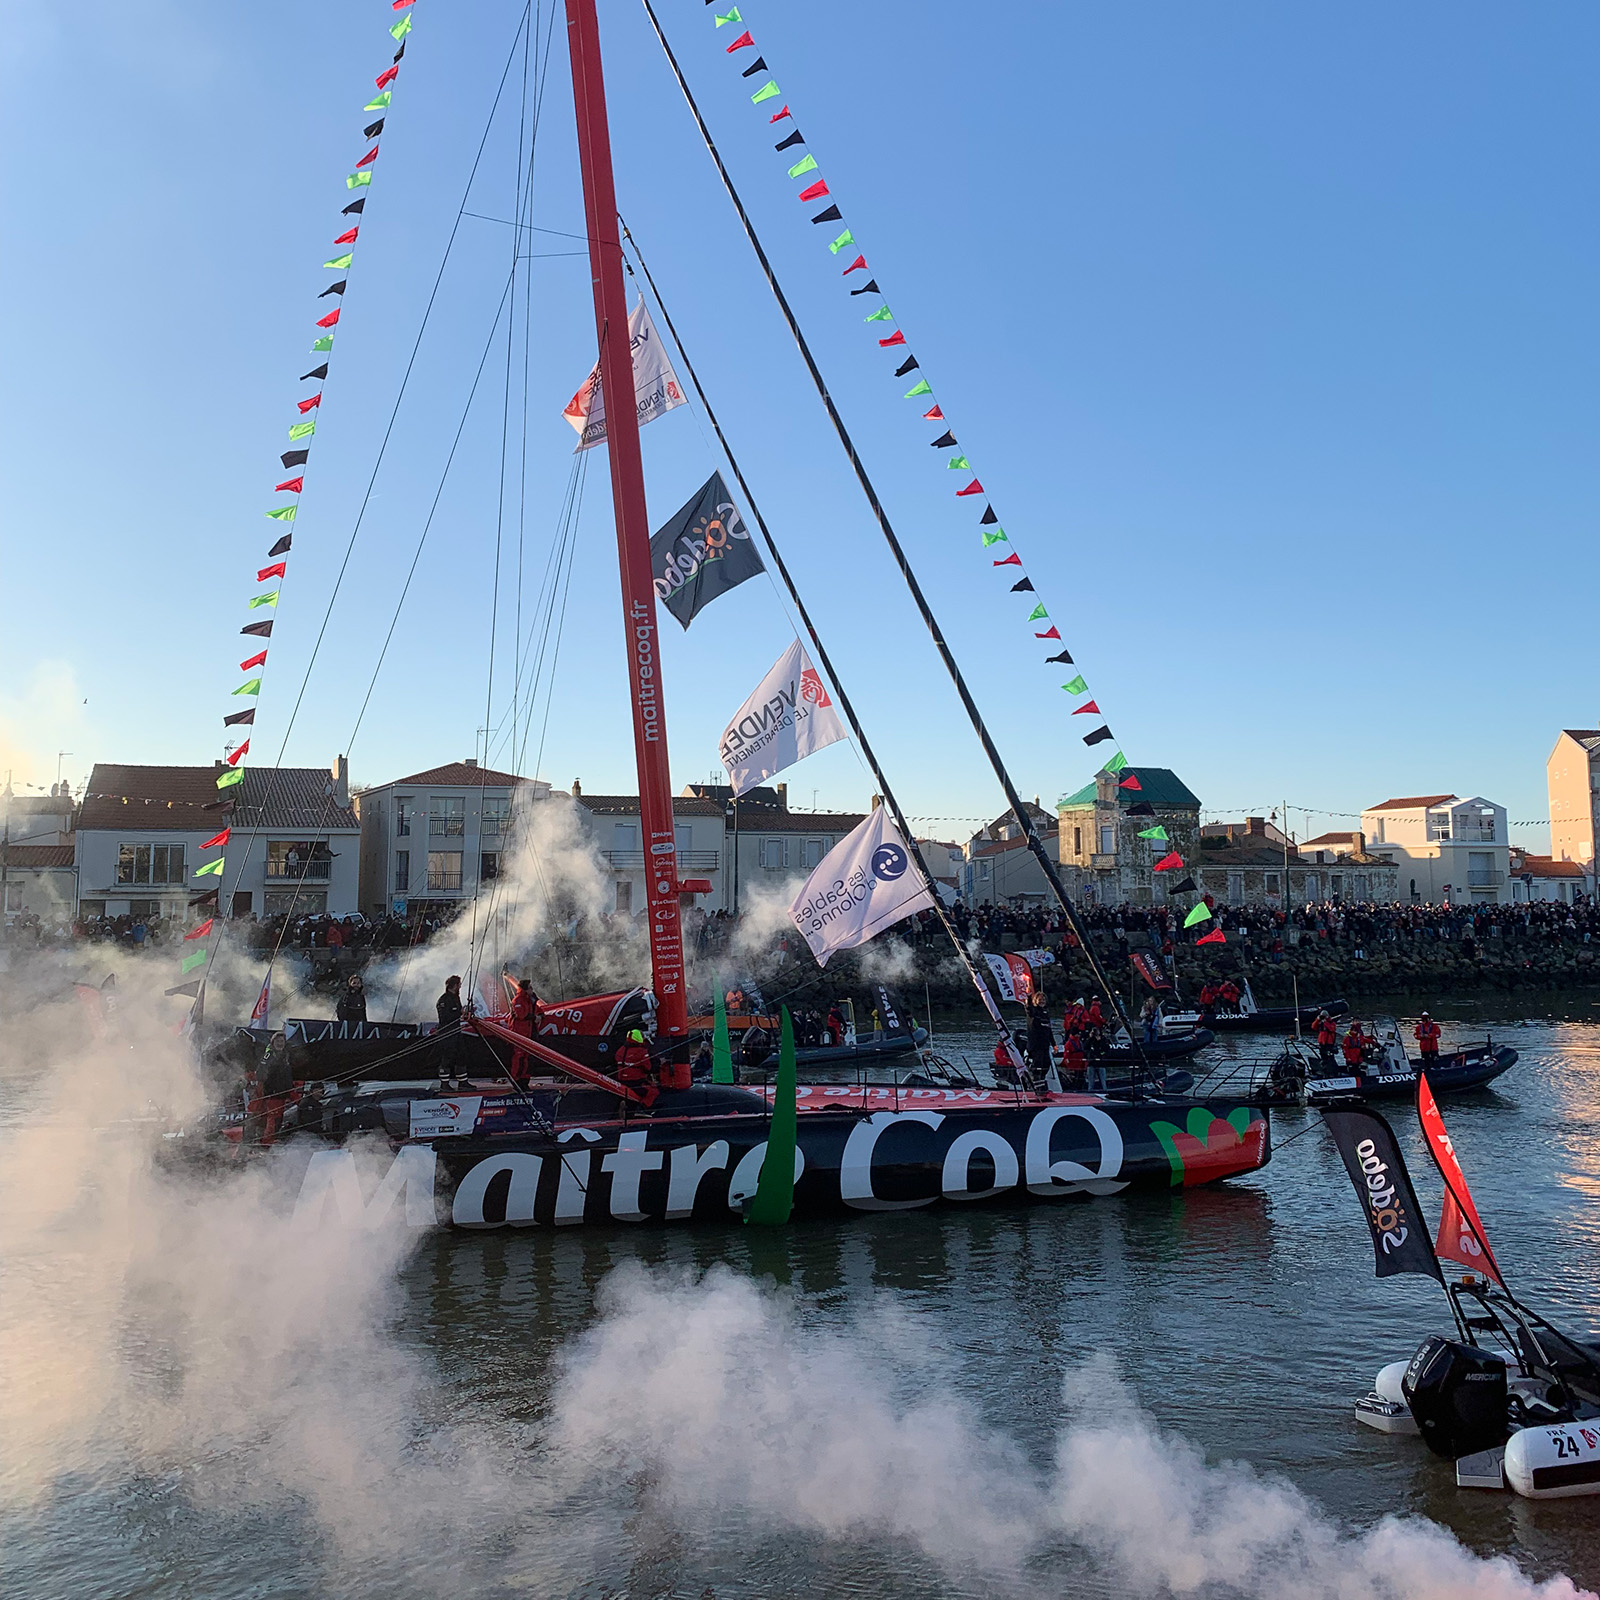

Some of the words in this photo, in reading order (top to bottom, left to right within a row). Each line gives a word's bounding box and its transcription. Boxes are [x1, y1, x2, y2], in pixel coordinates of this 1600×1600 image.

[630, 599, 659, 742] maitrecoq.fr
[1215, 1012, 1249, 1021] ZODIAC
[840, 1106, 1131, 1211] CoQ
[1546, 1429, 1567, 1437] FRA
[1552, 1436, 1580, 1459] 24
